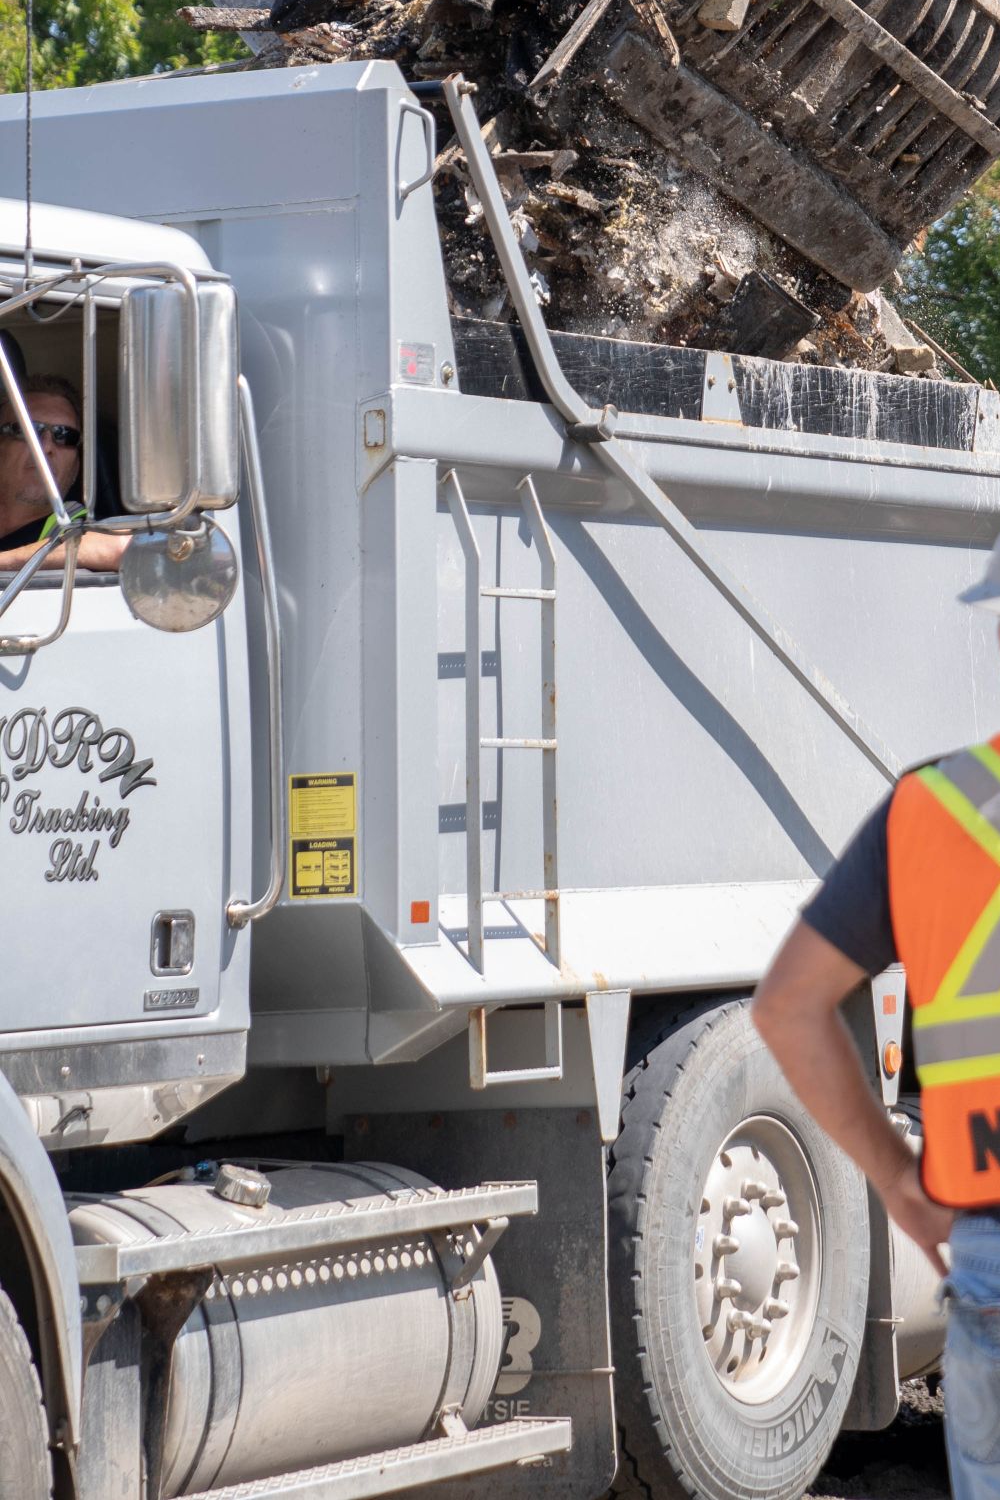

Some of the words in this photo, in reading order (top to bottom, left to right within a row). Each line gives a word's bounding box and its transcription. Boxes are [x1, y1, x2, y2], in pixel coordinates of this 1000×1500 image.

[0, 706, 157, 799] DRW
[308, 778, 337, 786] WARNING
[10, 789, 129, 848] Trucking
[45, 838, 99, 882] Ltd.
